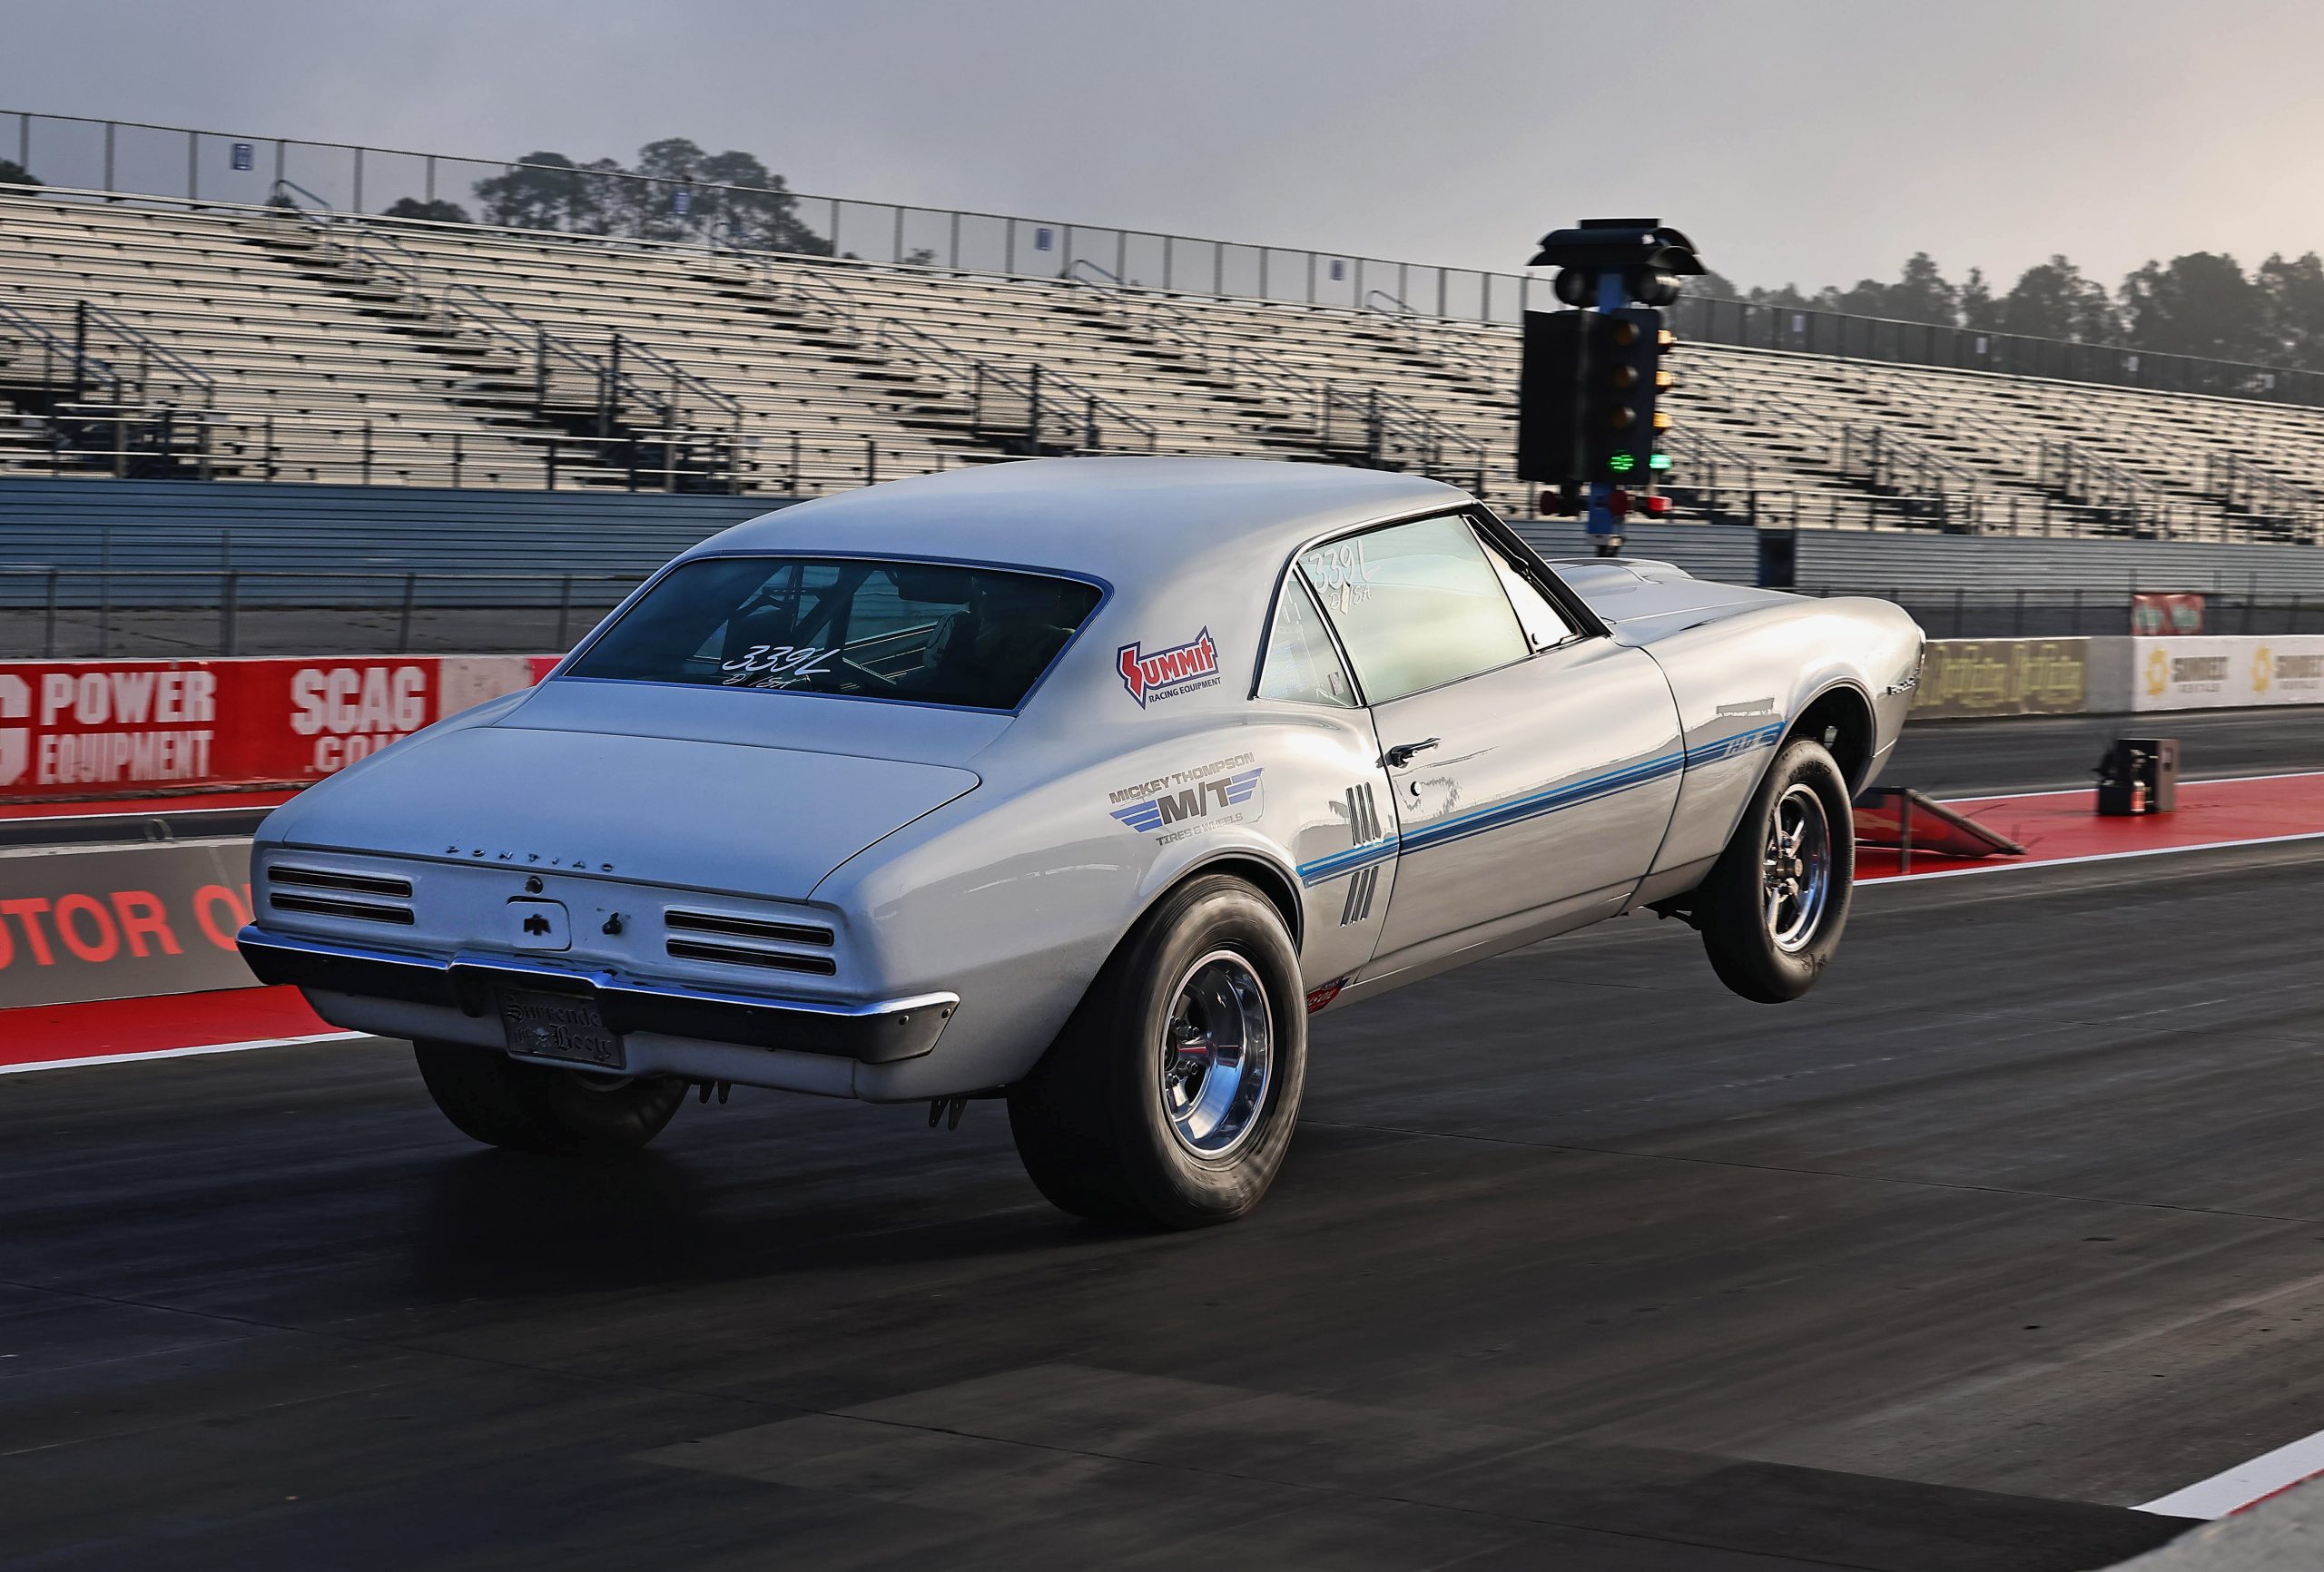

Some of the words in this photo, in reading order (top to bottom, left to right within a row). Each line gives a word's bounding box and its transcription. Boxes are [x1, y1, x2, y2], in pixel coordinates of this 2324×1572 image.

[1309, 538, 1381, 594] 339L
[722, 644, 842, 676] 339L
[40, 671, 217, 726] POWER
[290, 666, 427, 735] SCAG
[1148, 688, 1179, 703] RACING
[1179, 676, 1222, 695] EQUIPMENT
[37, 730, 215, 786] EQUIPMENT
[304, 733, 408, 773] .CO
[1108, 776, 1170, 804] MICKEY
[1171, 752, 1256, 785] THOMPSON
[1157, 777, 1234, 825] M/T
[1156, 828, 1194, 846] TIRES
[1201, 812, 1244, 832] WHEELS
[0, 890, 184, 970] TOR
[192, 884, 255, 952] O
[501, 993, 603, 1028] Surrende
